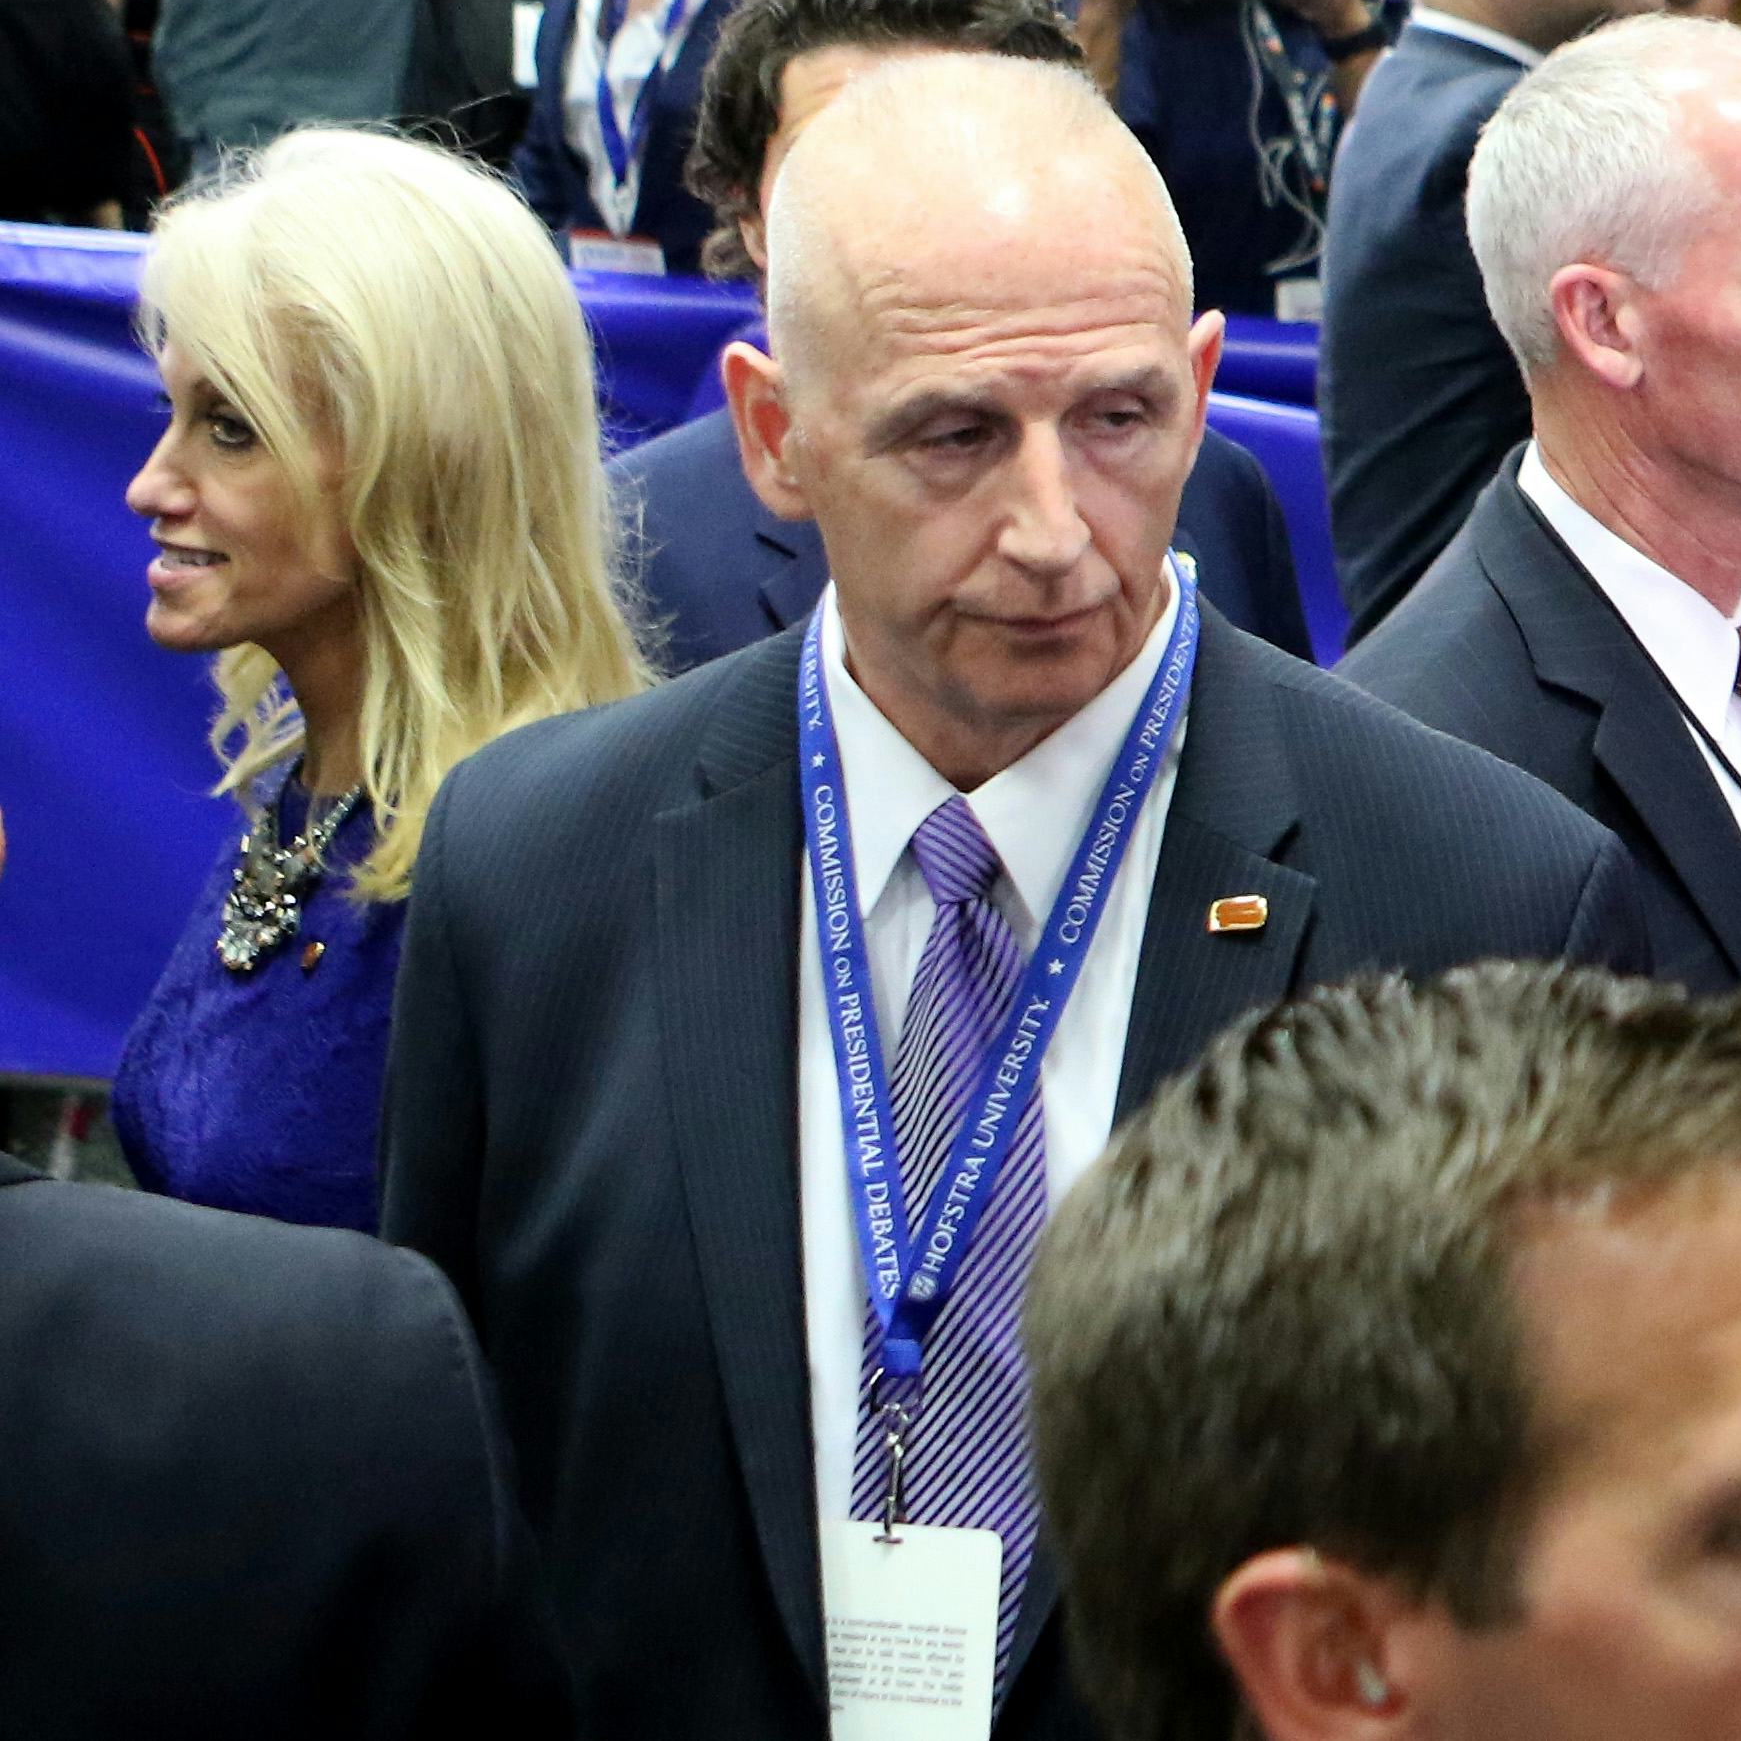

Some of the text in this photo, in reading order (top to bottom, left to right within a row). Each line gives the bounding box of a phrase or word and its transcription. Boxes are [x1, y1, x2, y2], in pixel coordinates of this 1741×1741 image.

[1059, 783, 1136, 944] COMMISSION
[1130, 753, 1152, 782] ON
[814, 784, 900, 1301] COMMISSION ON PRESIDENTIAL DEBATES
[922, 1155, 986, 1273] HOFSTRA
